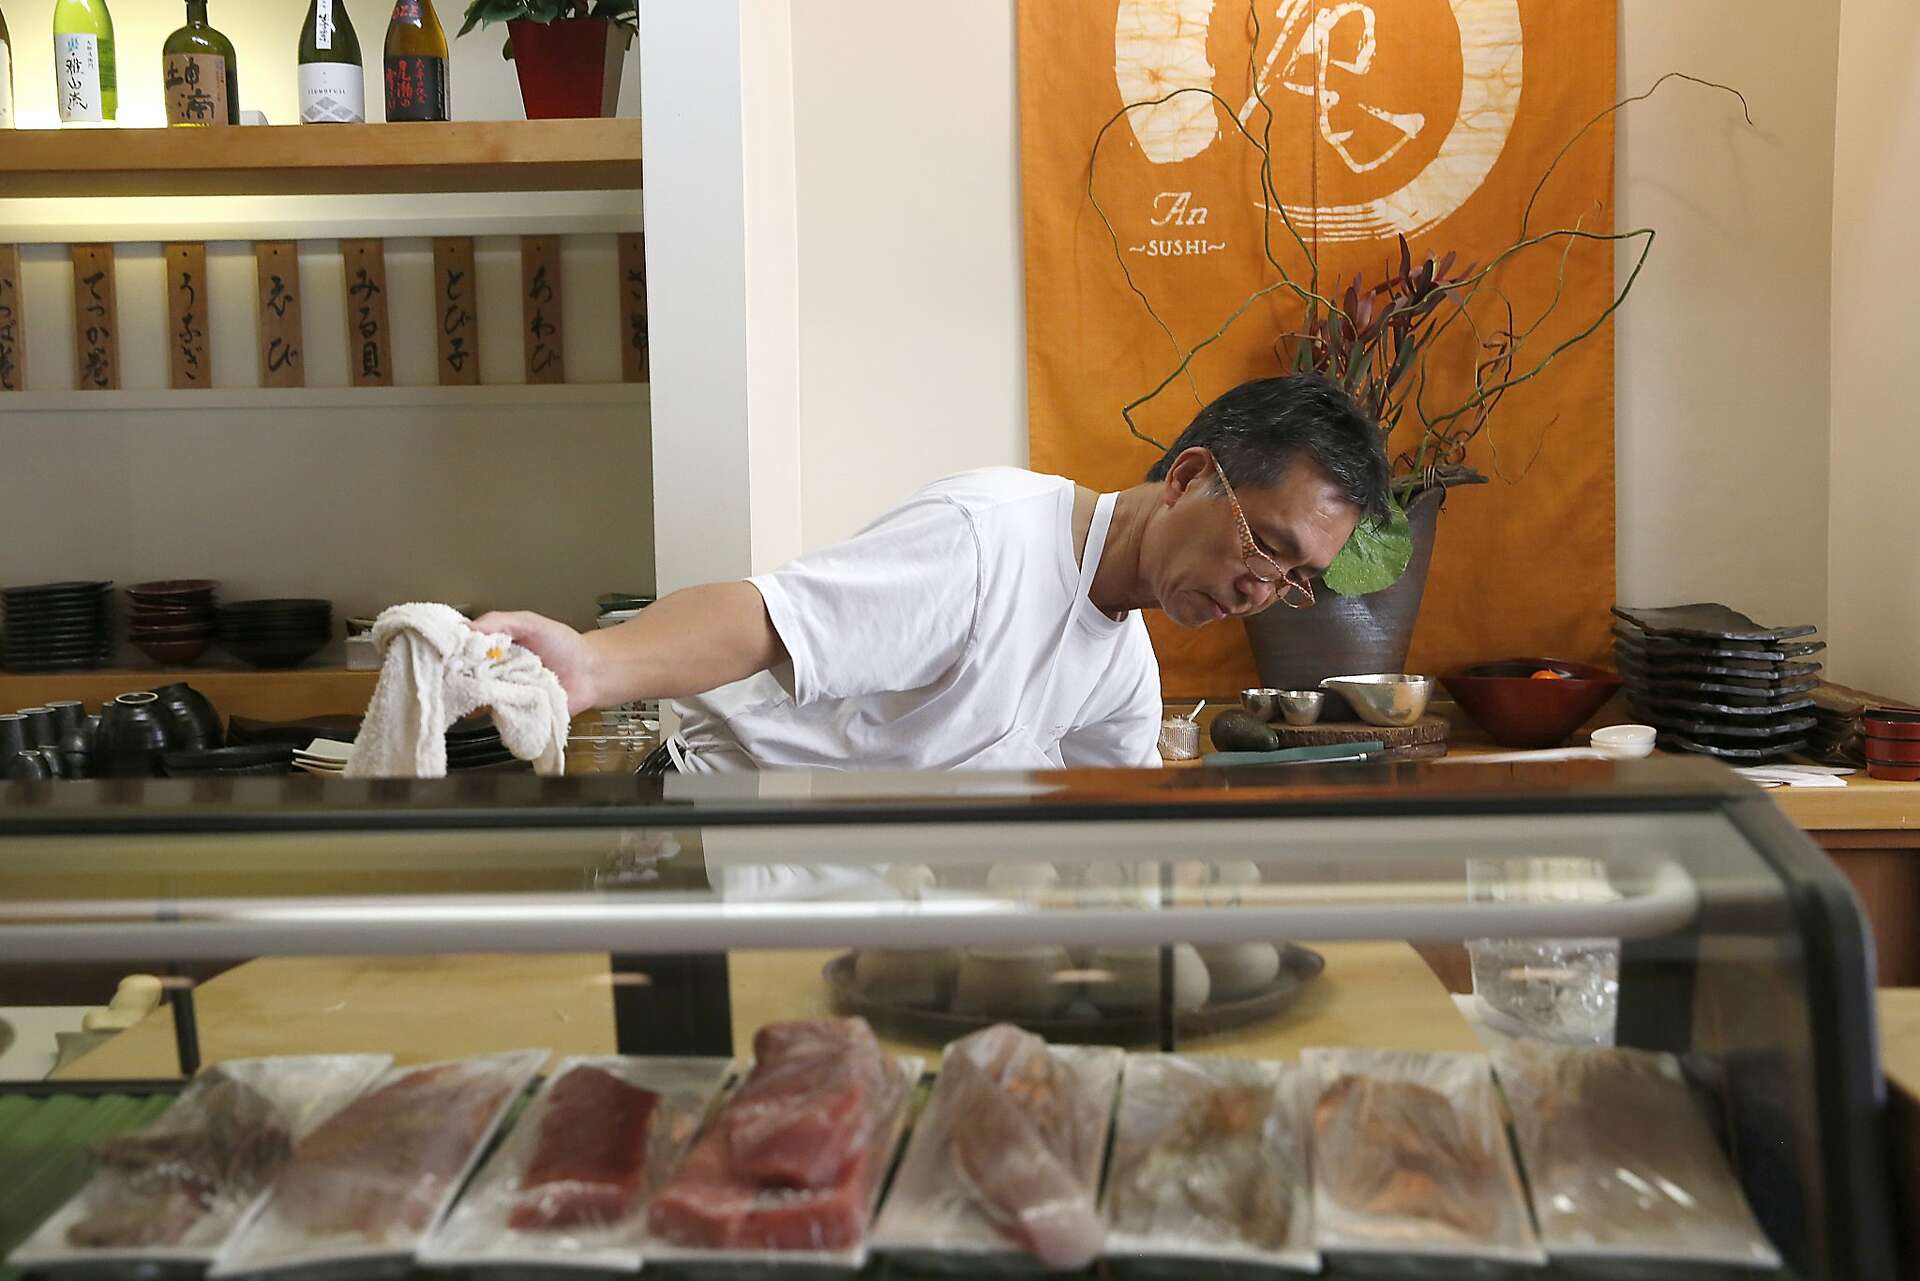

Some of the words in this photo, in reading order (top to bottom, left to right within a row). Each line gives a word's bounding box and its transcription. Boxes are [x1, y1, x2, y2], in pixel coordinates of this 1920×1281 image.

[1150, 191, 1208, 226] An
[349, 269, 382, 378] みる貝
[444, 268, 472, 373] とび子
[529, 264, 561, 375] あわび
